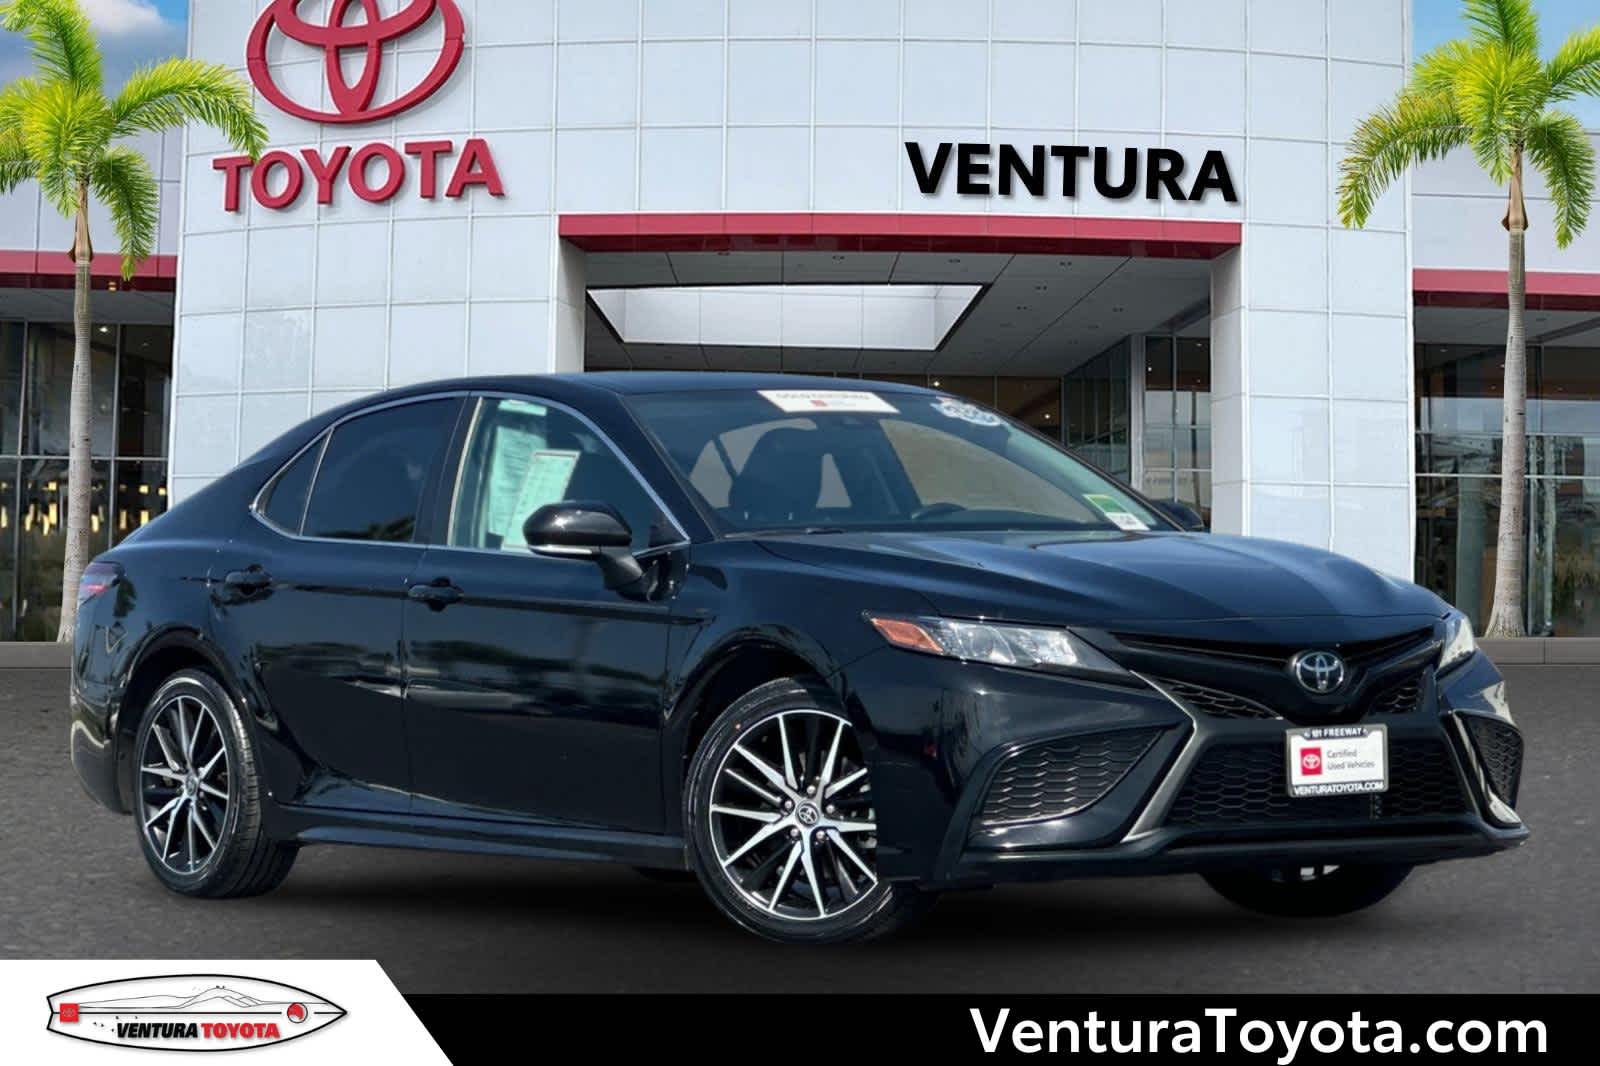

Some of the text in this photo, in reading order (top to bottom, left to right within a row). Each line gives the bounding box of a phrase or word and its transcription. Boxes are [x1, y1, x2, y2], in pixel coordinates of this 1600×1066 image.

[212, 138, 505, 212] TOYOTA
[904, 141, 1240, 202] VENTURA
[1324, 727, 1361, 737] FREEWAY
[1294, 781, 1384, 796] VENTURATOYOTA.COM
